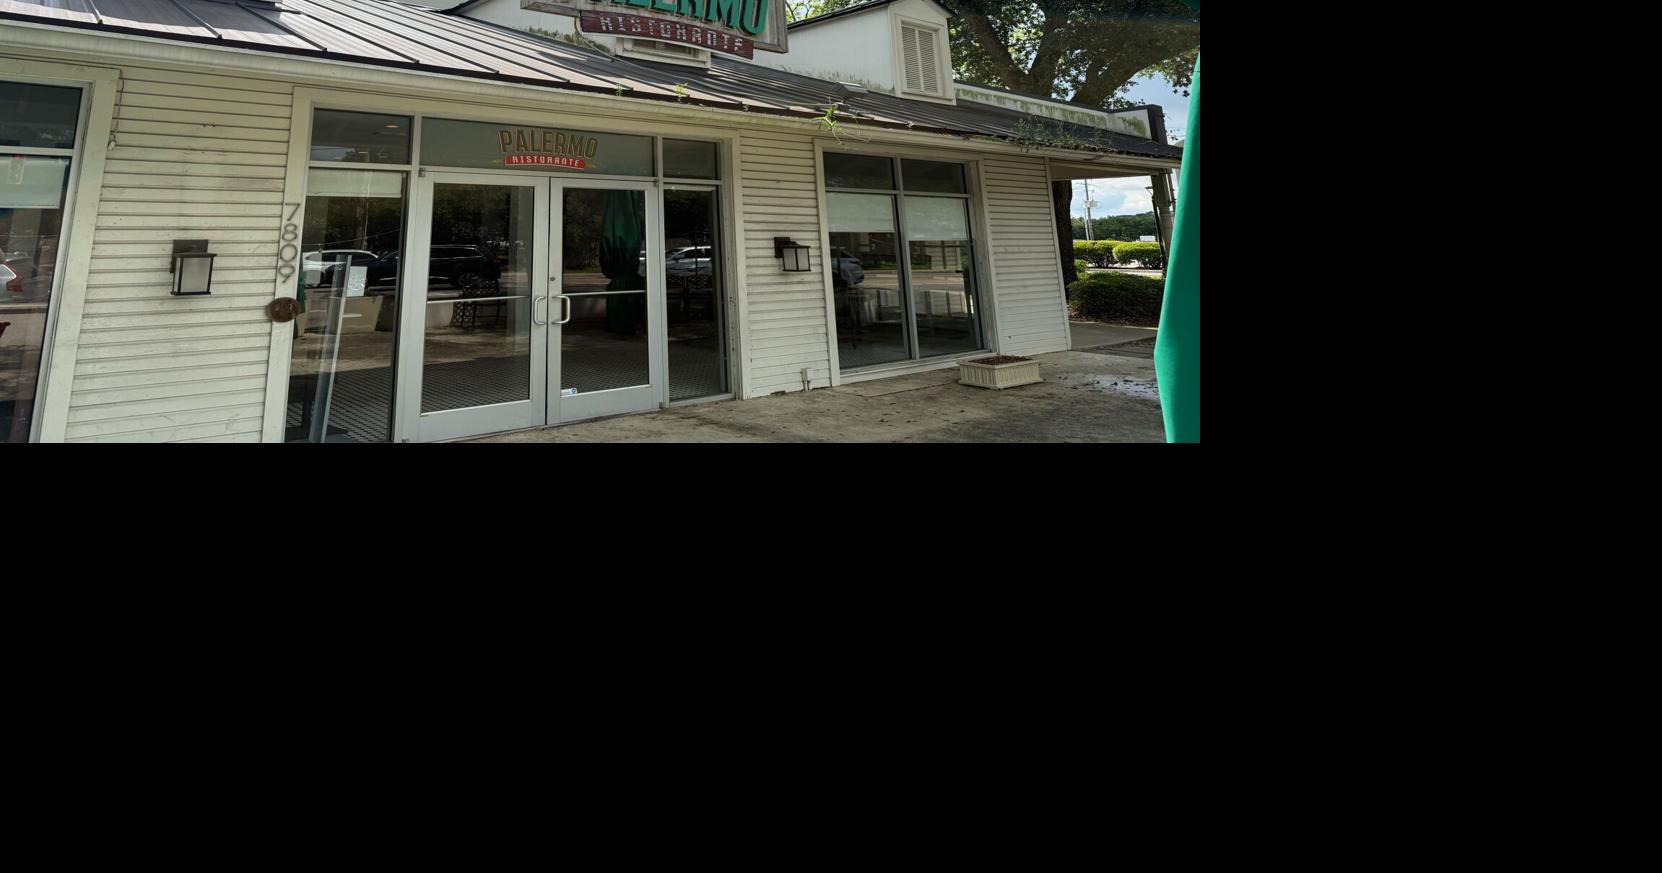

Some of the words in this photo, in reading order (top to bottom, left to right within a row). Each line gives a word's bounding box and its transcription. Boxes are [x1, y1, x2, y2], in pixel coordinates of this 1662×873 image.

[497, 128, 598, 159] PALERMO
[512, 155, 580, 167] RISTORANTE
[279, 202, 301, 284] 7809
